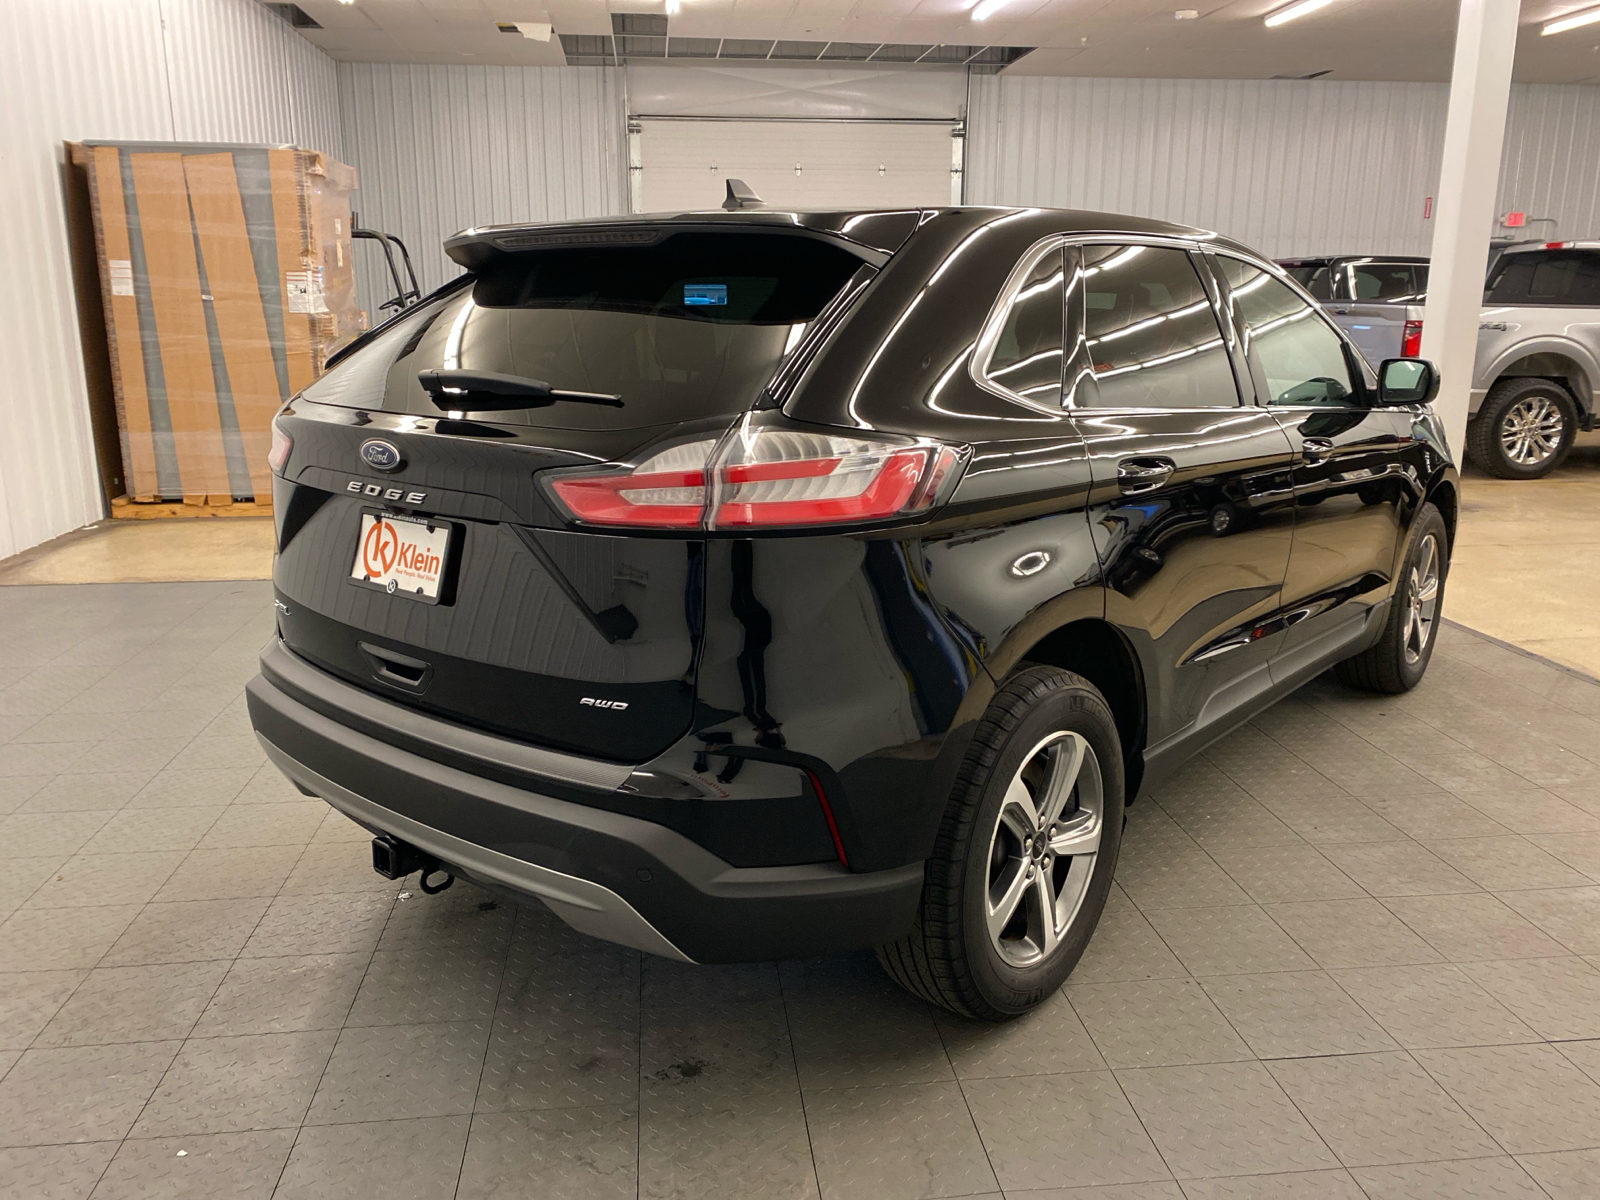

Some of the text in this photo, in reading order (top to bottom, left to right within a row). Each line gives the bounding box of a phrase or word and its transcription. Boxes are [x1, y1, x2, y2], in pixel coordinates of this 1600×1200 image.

[367, 445, 389, 463] Ford
[347, 481, 427, 504] EDGE
[397, 542, 440, 575] Klein
[580, 697, 629, 710] AWD
